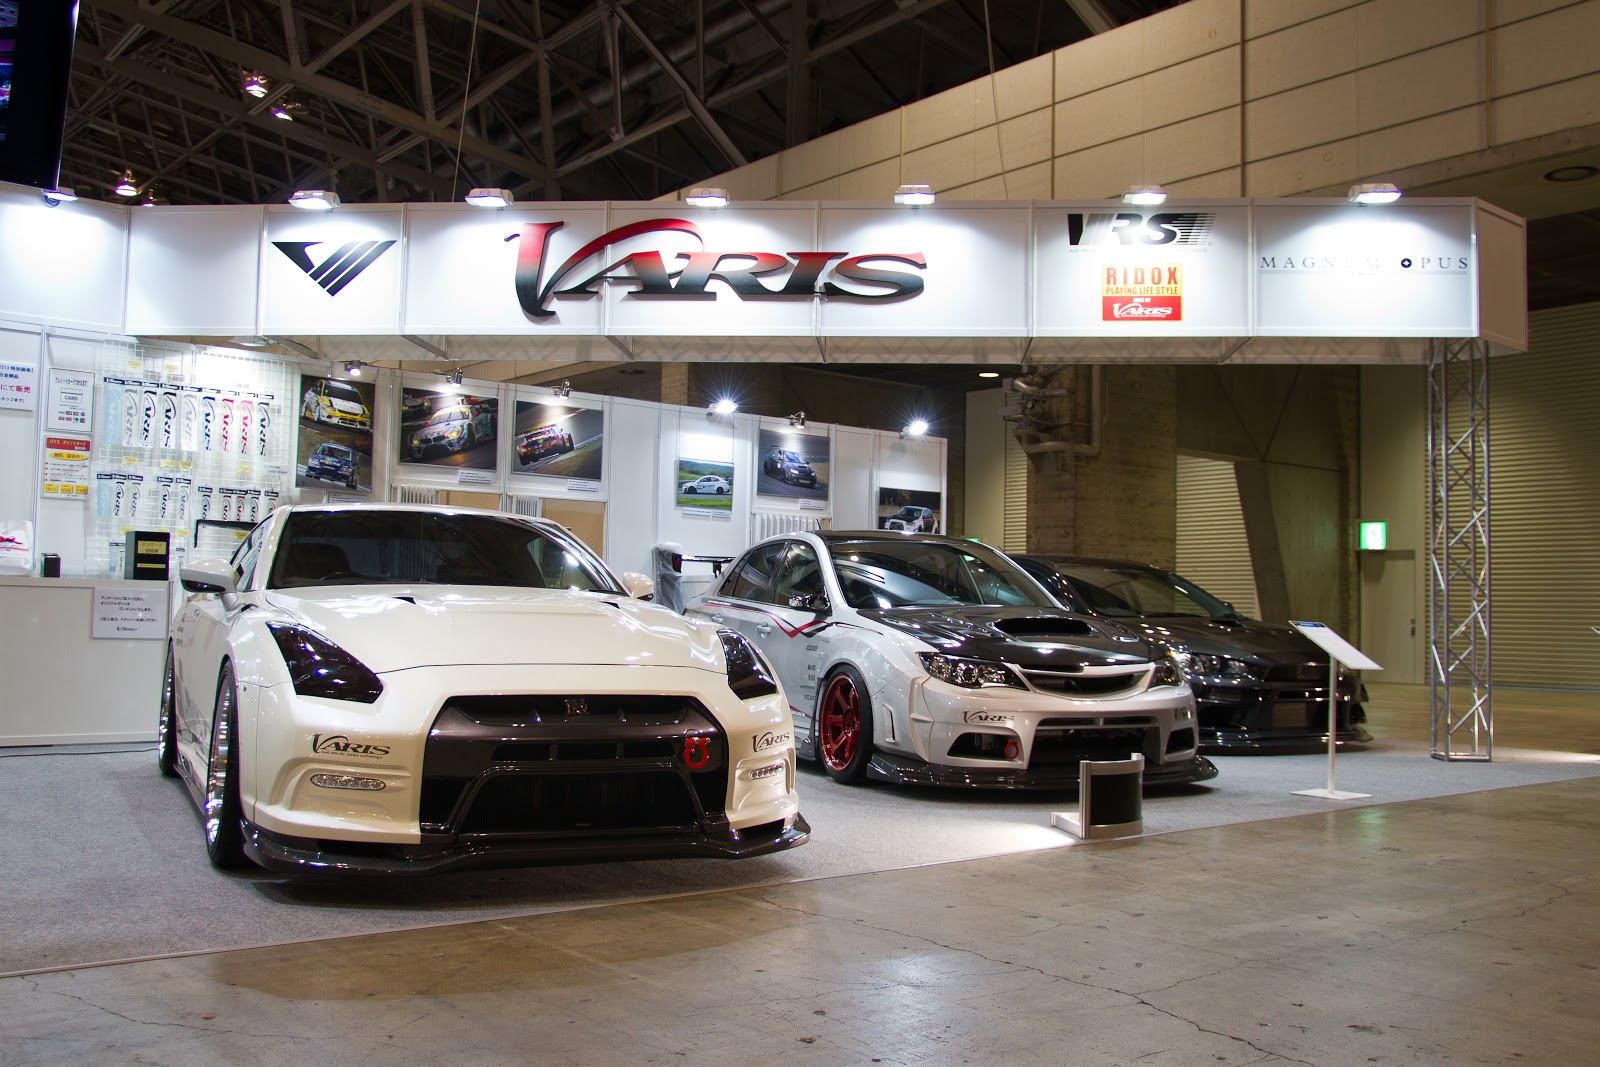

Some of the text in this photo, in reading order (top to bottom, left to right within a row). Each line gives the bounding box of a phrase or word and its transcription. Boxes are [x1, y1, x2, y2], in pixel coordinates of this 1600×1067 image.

[504, 218, 928, 318] VARIS
[1106, 267, 1178, 285] RIDOX
[1106, 286, 1178, 295] PLAYING LIFE STYLE
[1112, 302, 1173, 318] VARIS
[962, 710, 1015, 724] VARIS
[313, 734, 390, 755] VARIS
[752, 731, 790, 753] VARIS
